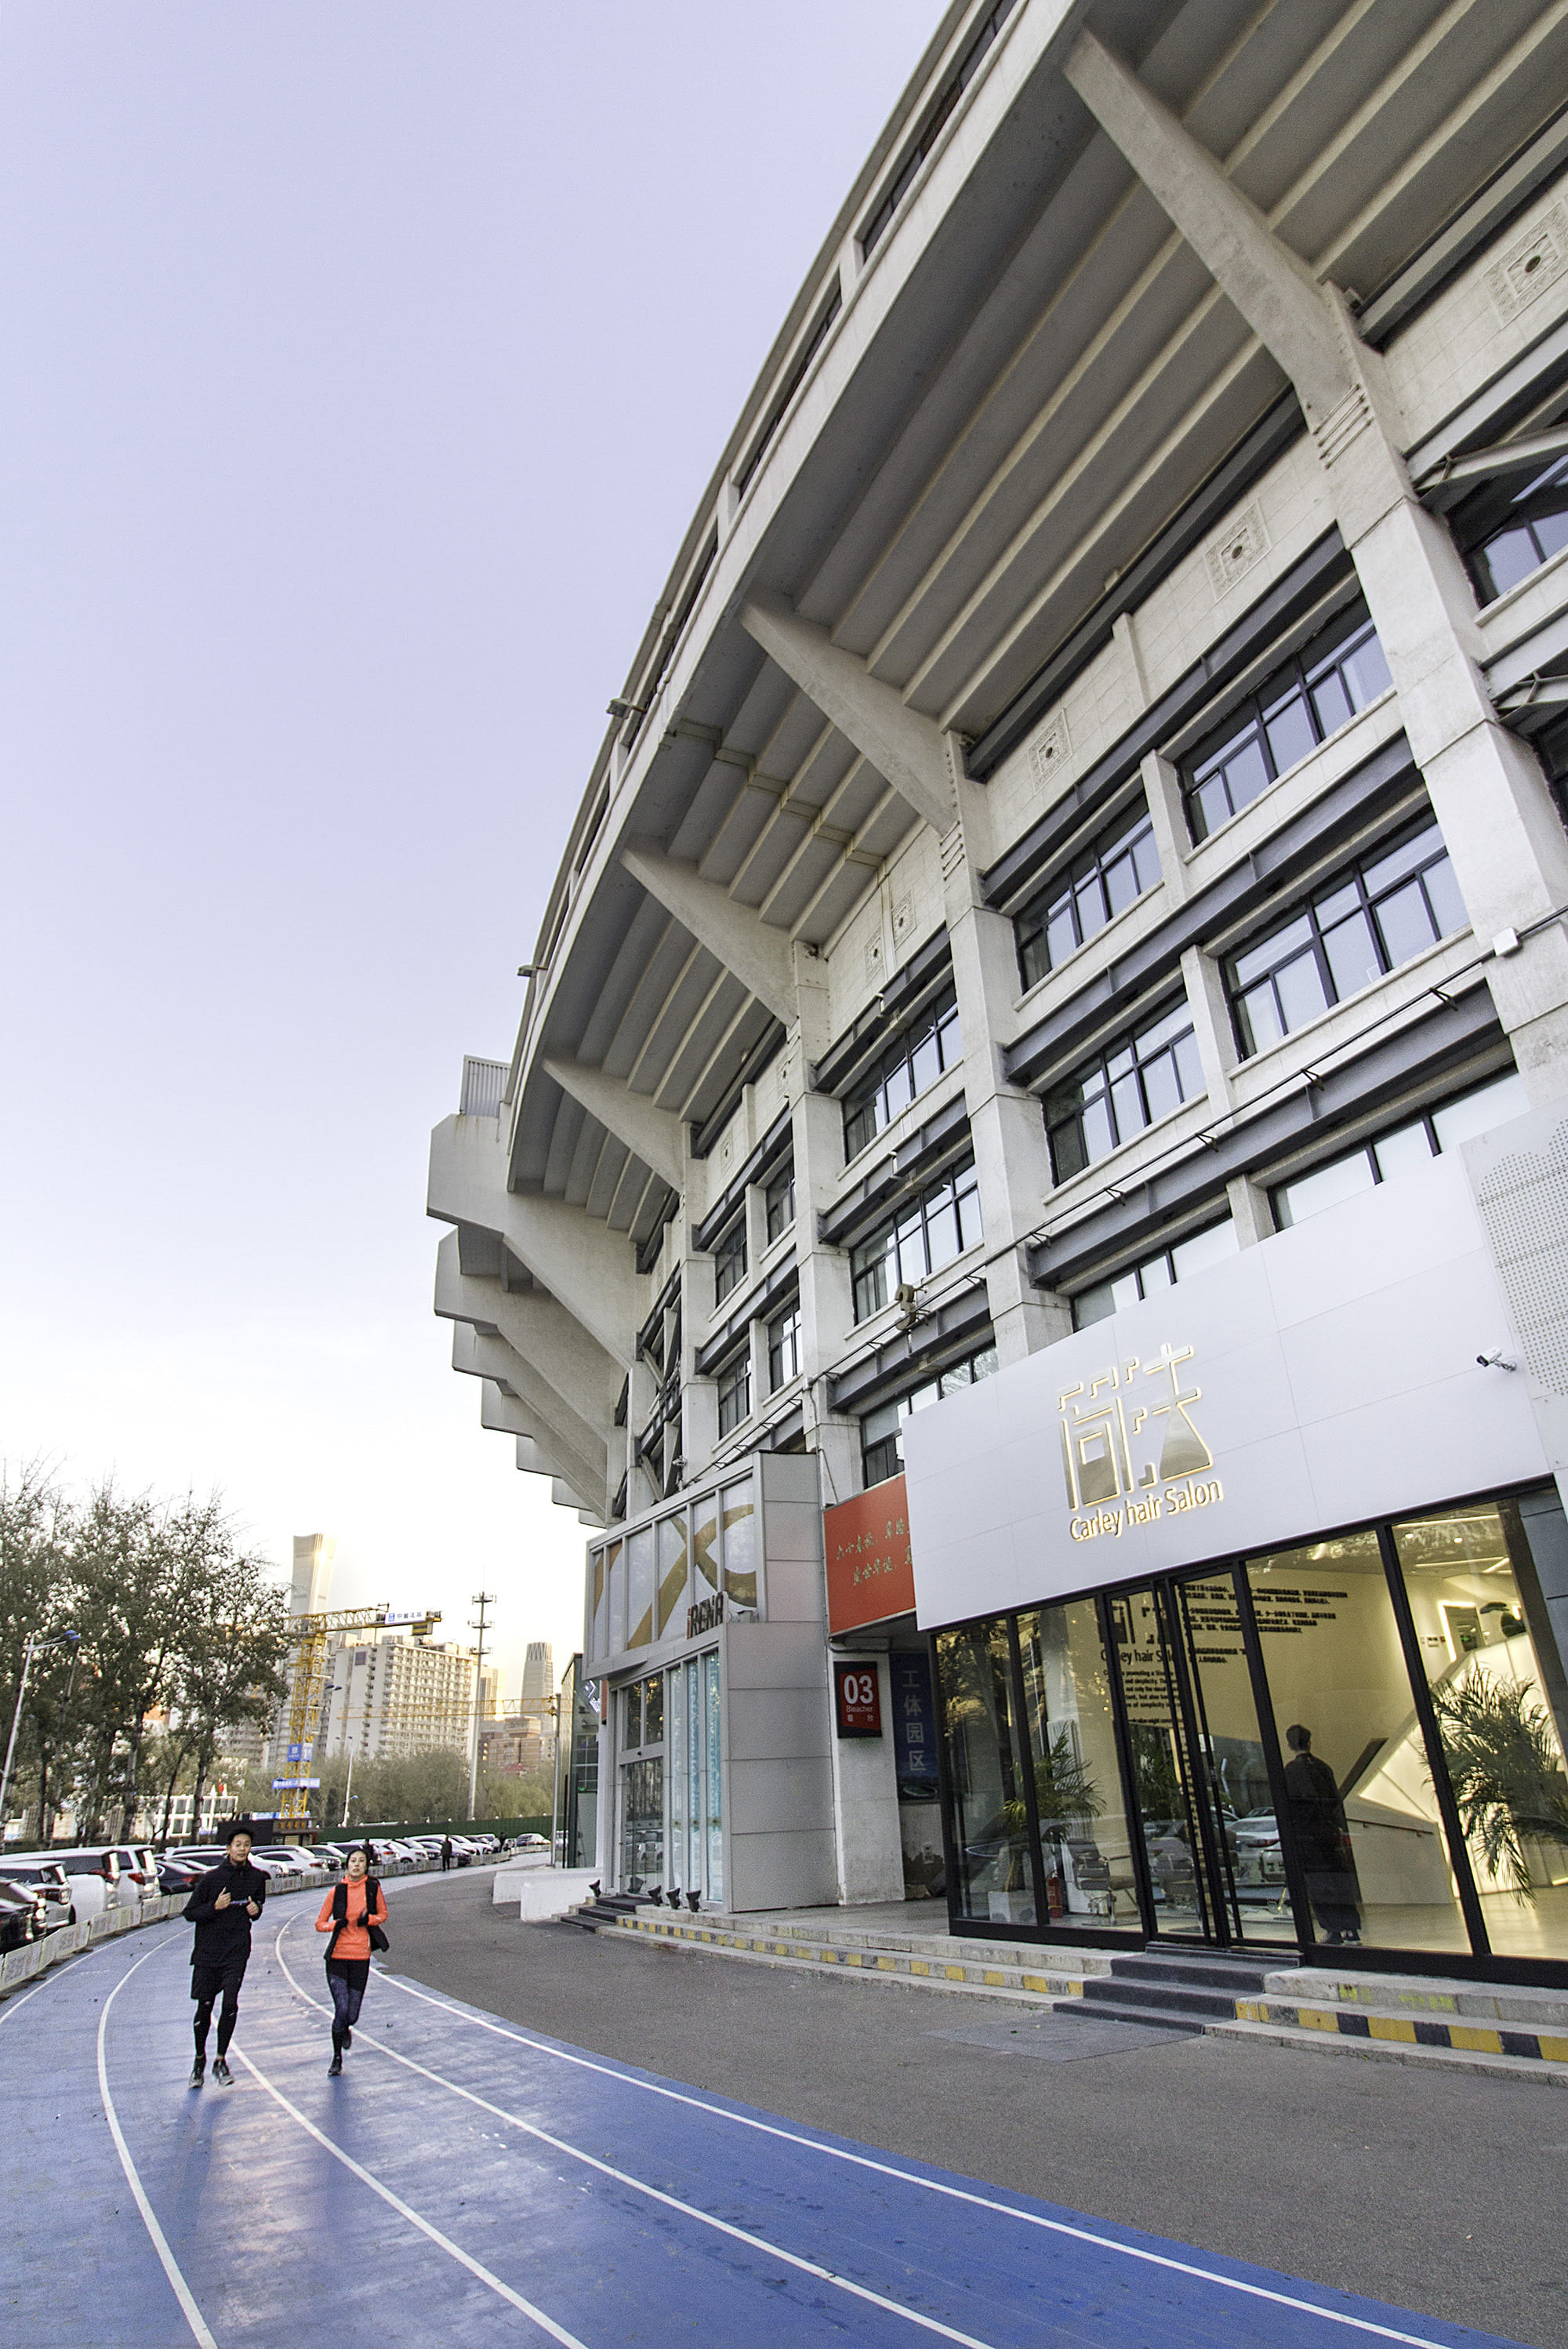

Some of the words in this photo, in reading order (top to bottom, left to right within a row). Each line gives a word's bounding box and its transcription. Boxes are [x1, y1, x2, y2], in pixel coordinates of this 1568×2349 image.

[1070, 1508, 1123, 1542] Carley
[1124, 1493, 1163, 1527] hair
[1166, 1479, 1225, 1517] Salon
[1134, 1649, 1154, 1662] hair
[844, 1674, 874, 1705] 03
[903, 1669, 927, 1772] 工体园区
